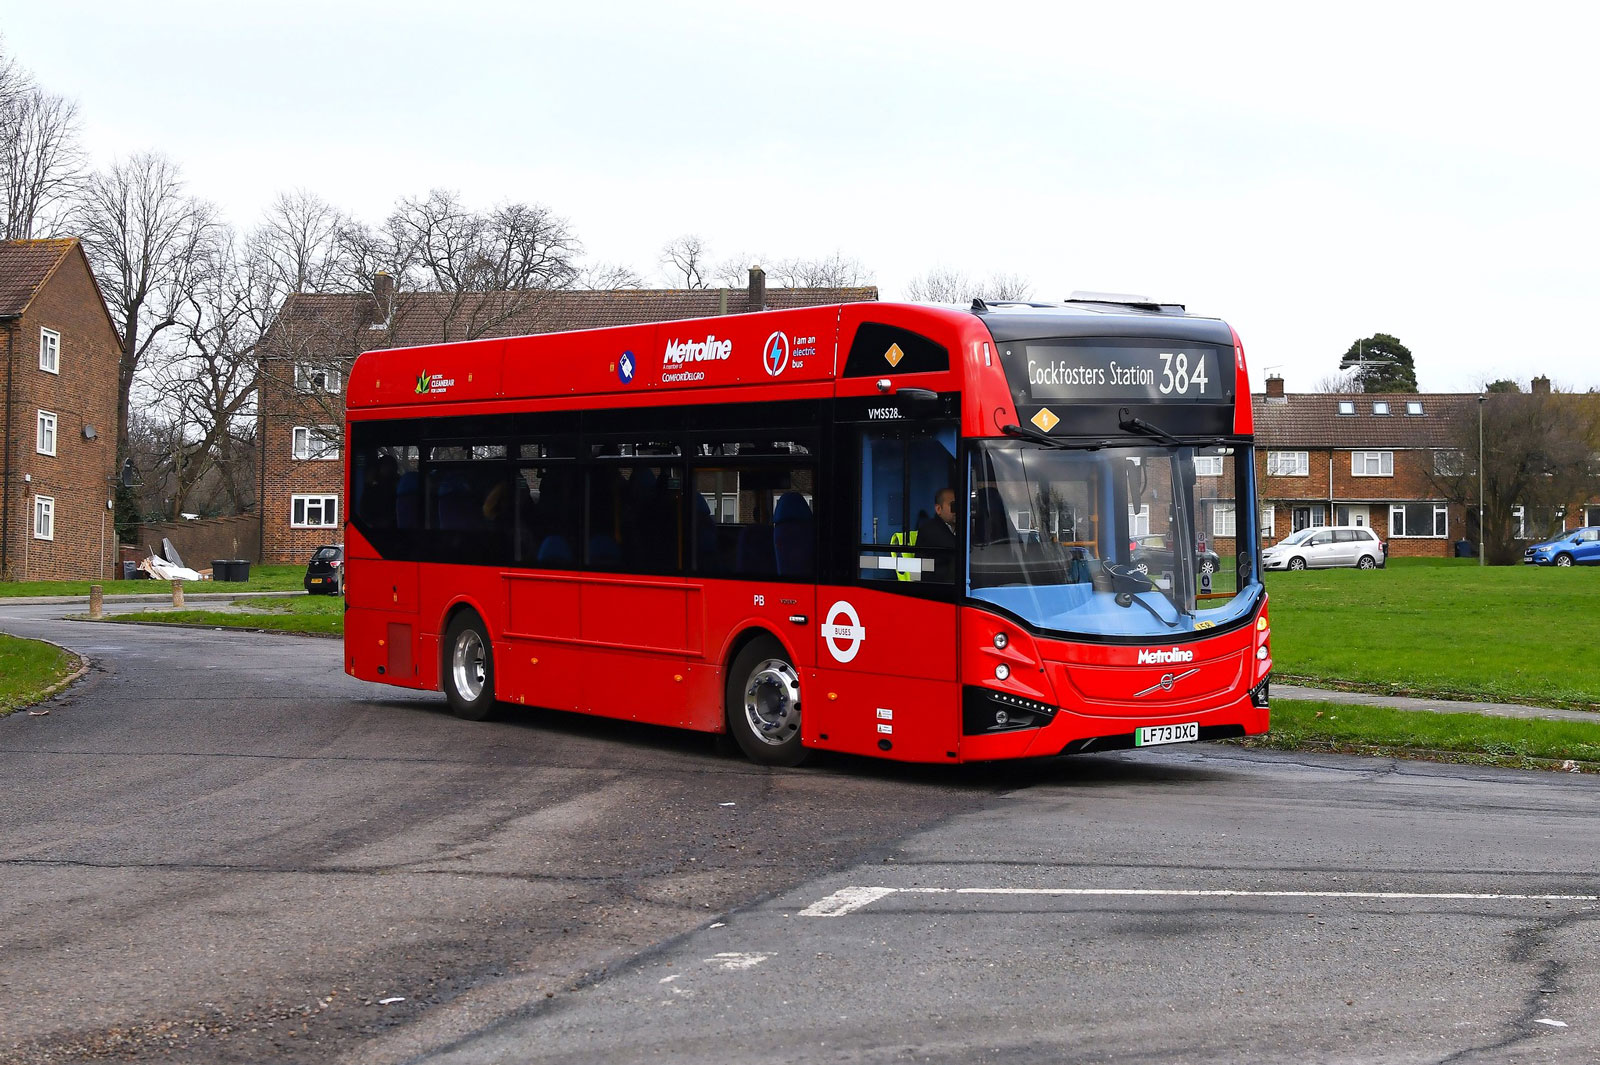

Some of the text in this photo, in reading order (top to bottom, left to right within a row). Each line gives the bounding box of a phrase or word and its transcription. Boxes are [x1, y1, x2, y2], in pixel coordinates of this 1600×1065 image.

[794, 336, 796, 345] I
[663, 335, 732, 363] Metroline
[793, 347, 816, 356] electric
[792, 360, 804, 368] bus
[1028, 359, 1154, 385] Cockfosters Station
[1159, 353, 1208, 394] 384
[868, 407, 906, 420] VMSS28
[754, 595, 764, 606] PB
[834, 628, 851, 636] BUSES
[1138, 647, 1193, 664] Metroline
[1143, 724, 1196, 742] LF73 DXC
